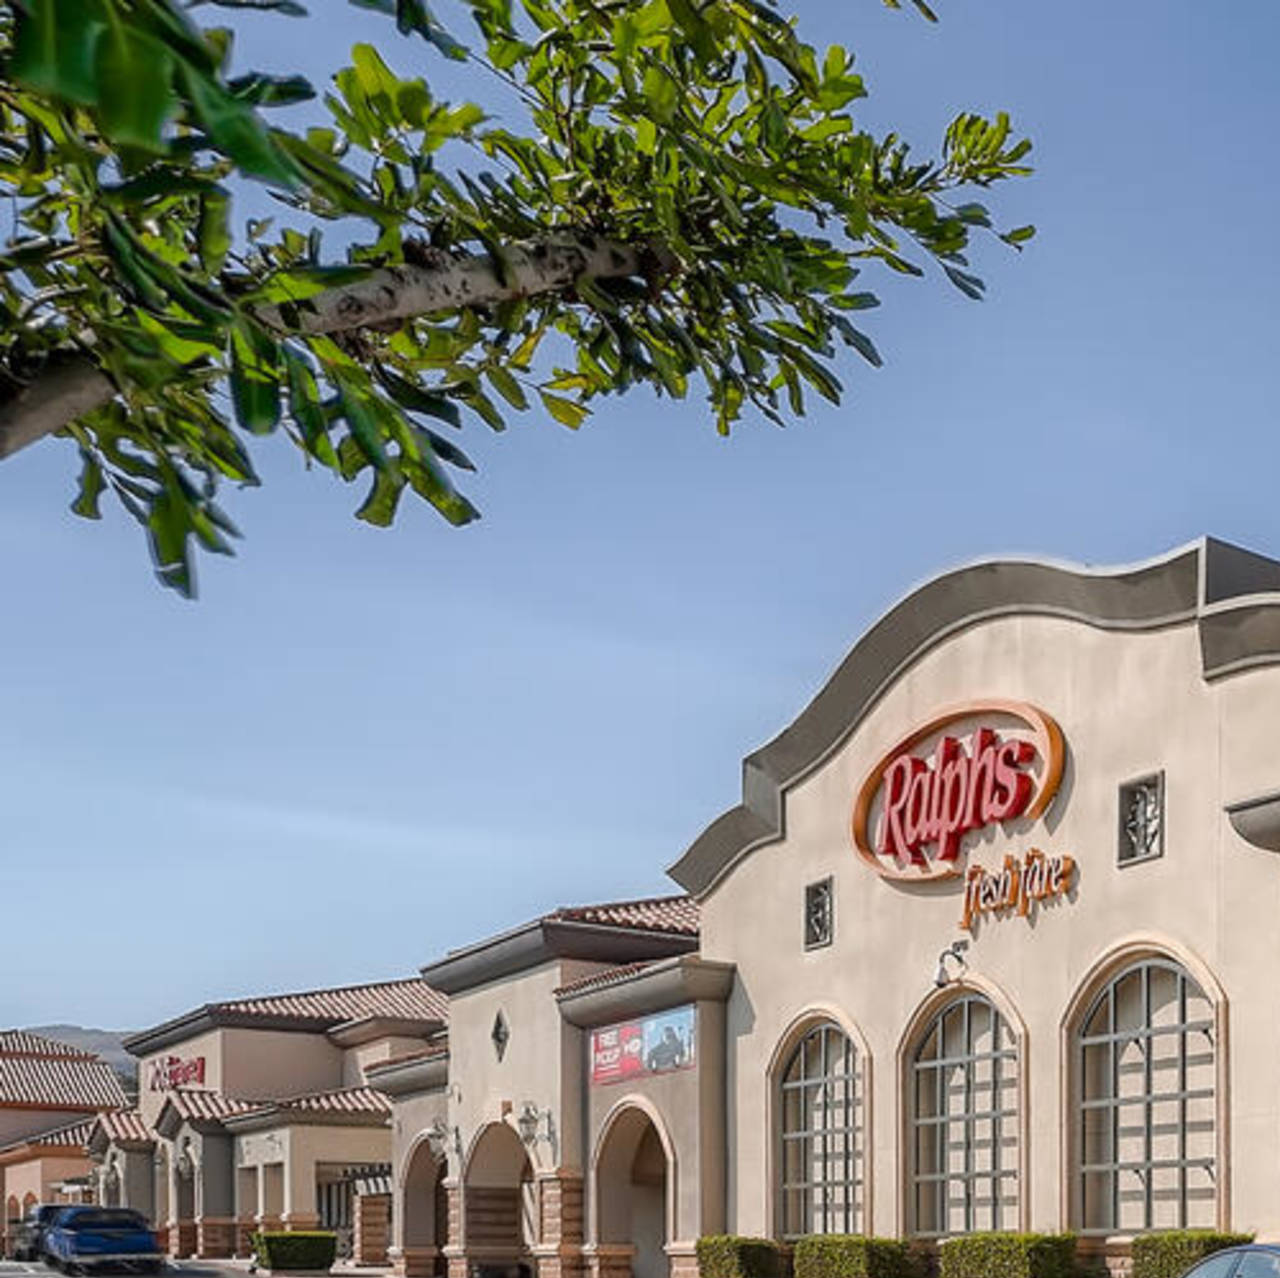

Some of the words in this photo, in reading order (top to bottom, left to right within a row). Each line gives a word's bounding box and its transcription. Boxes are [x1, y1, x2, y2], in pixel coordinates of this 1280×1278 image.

[877, 727, 1034, 866] Ralphs
[958, 855, 1020, 930] fresh
[1015, 847, 1075, 917] fare
